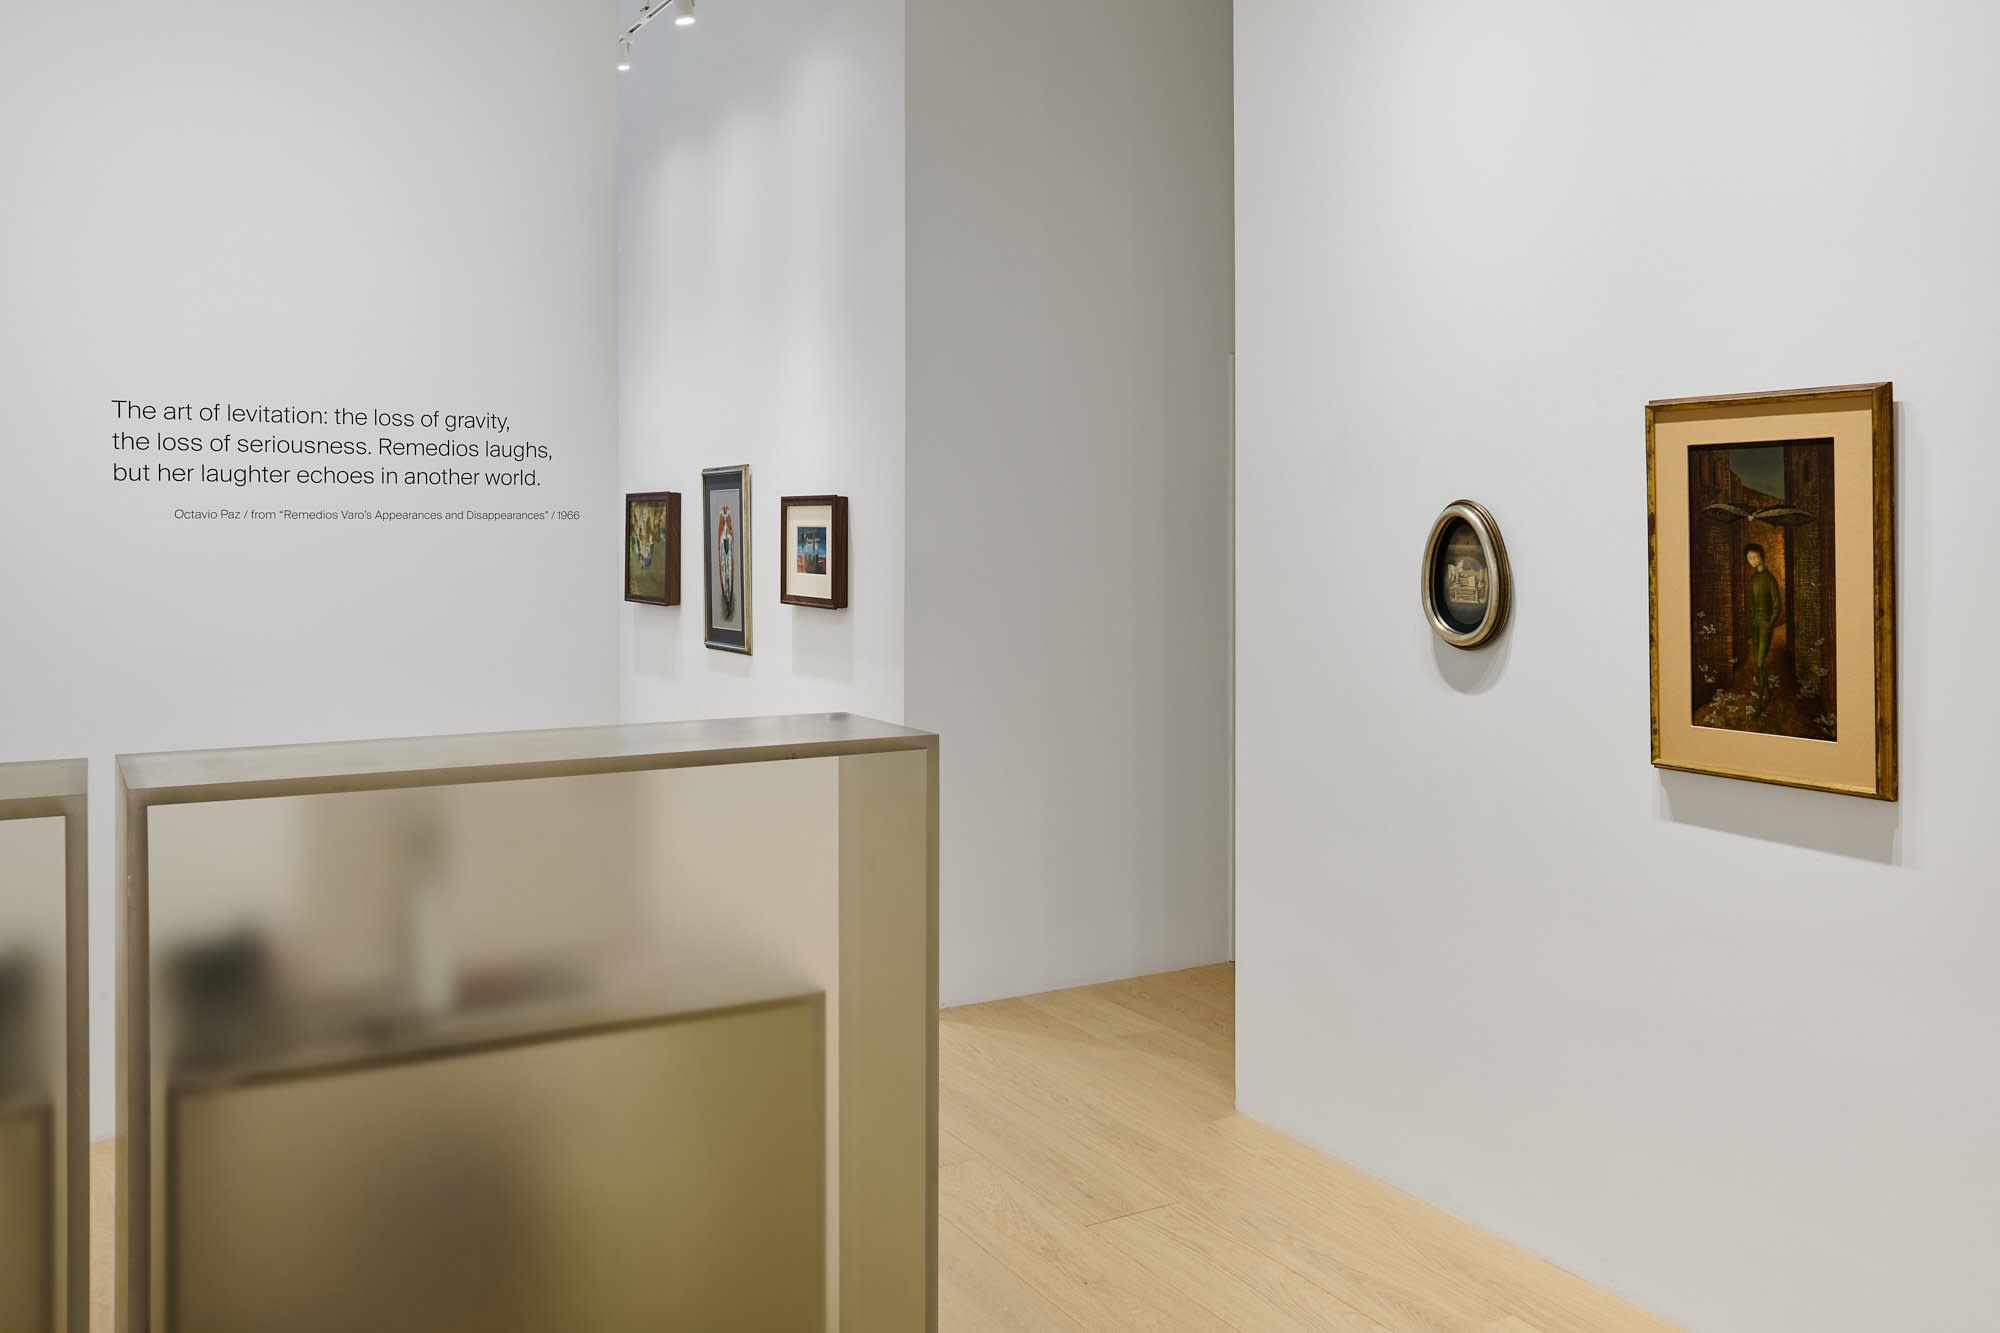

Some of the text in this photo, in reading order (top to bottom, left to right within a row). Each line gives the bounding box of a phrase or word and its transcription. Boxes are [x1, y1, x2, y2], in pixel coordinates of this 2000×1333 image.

[111, 400, 509, 433] The art of levitation: the loss of gravity,
[112, 432, 552, 462] the loss of seriousness. Remedios laughs,
[114, 462, 540, 487] but her laughter echoes in another world.
[174, 509, 218, 520] Octavio
[221, 509, 241, 520] Paz
[251, 509, 277, 520] from
[375, 510, 442, 522] Appearances
[445, 511, 464, 520] and
[557, 510, 580, 520] 1966
